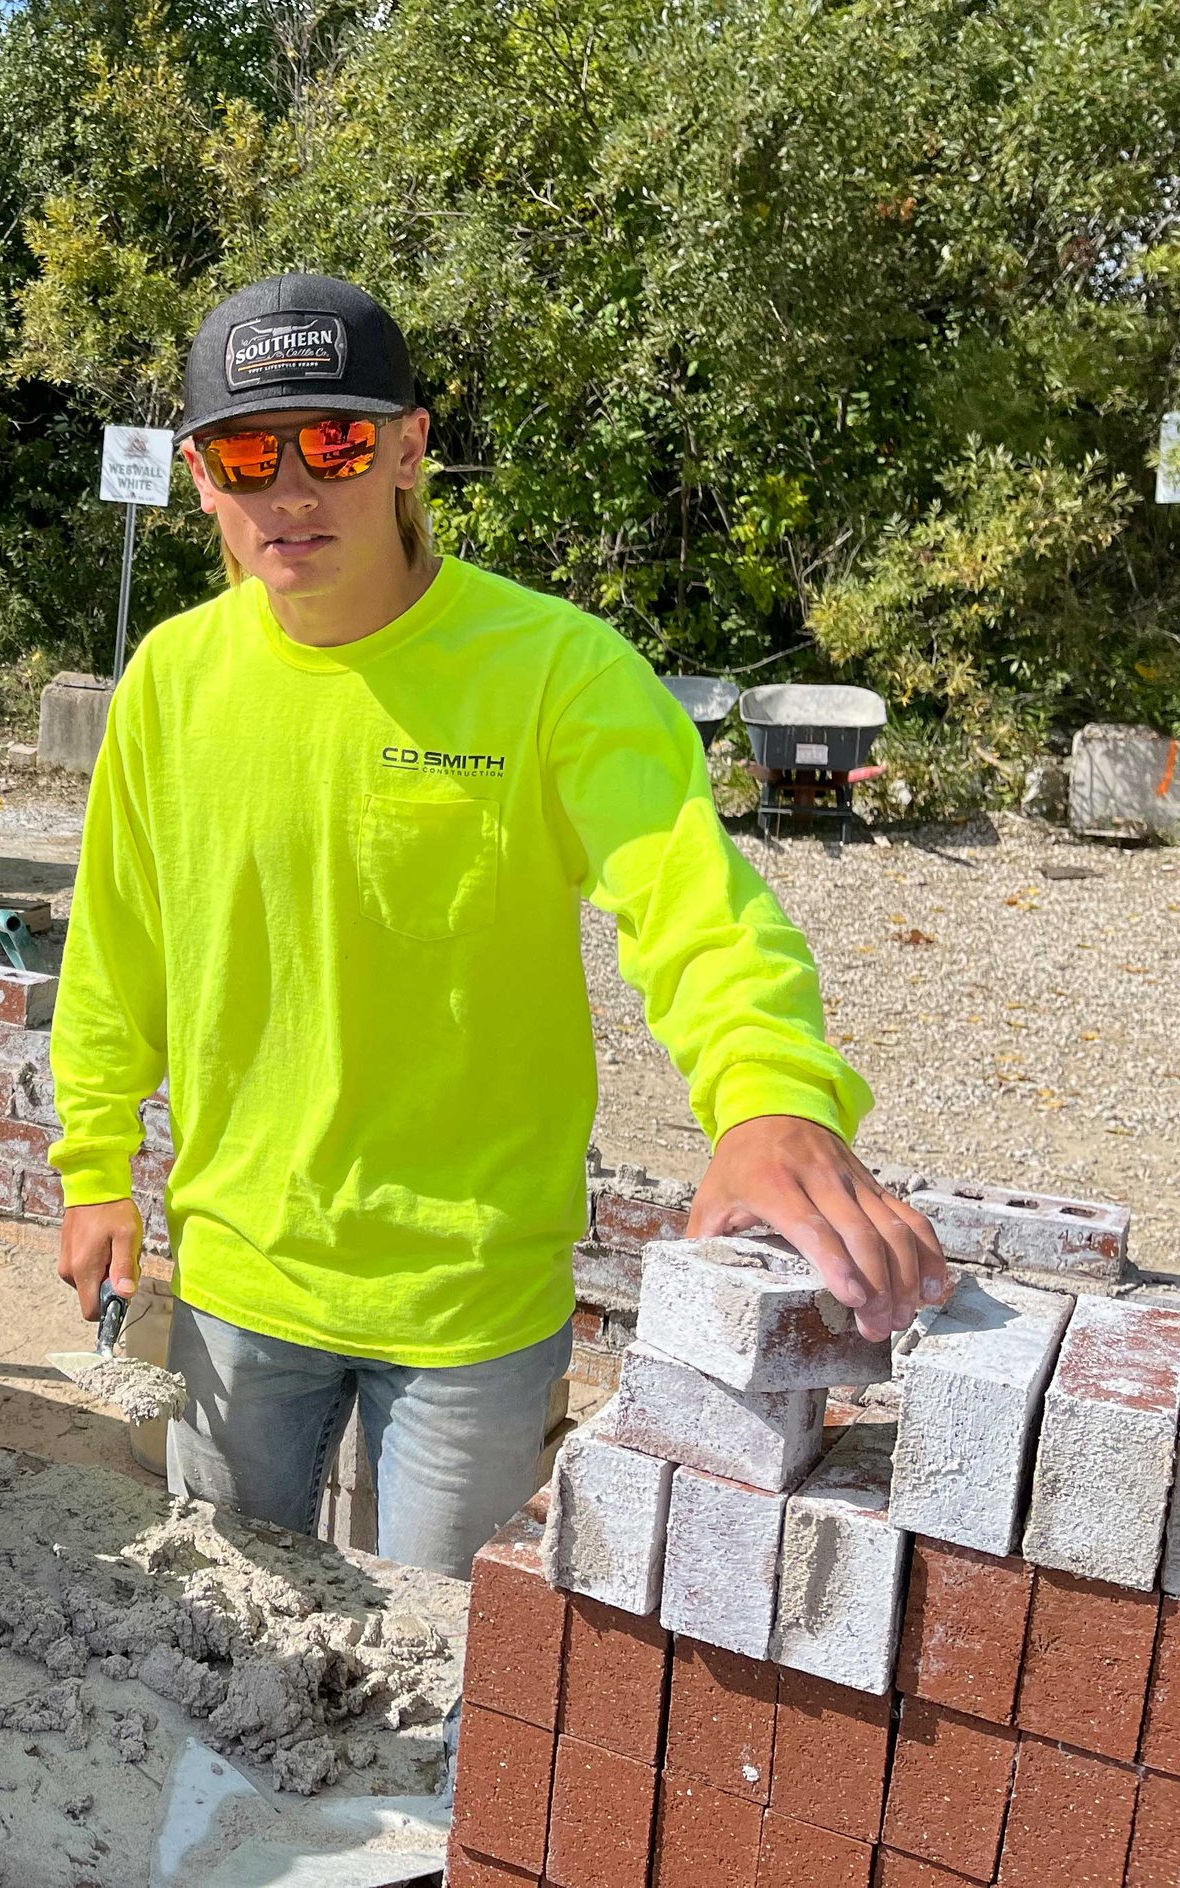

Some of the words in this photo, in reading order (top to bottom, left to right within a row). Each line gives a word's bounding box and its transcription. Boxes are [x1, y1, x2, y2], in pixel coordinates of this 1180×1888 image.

[235, 330, 333, 365] SOUTHERN
[117, 477, 153, 491] WHITE
[423, 751, 505, 770] SMITH
[422, 766, 504, 778] CONSTRUCTION
